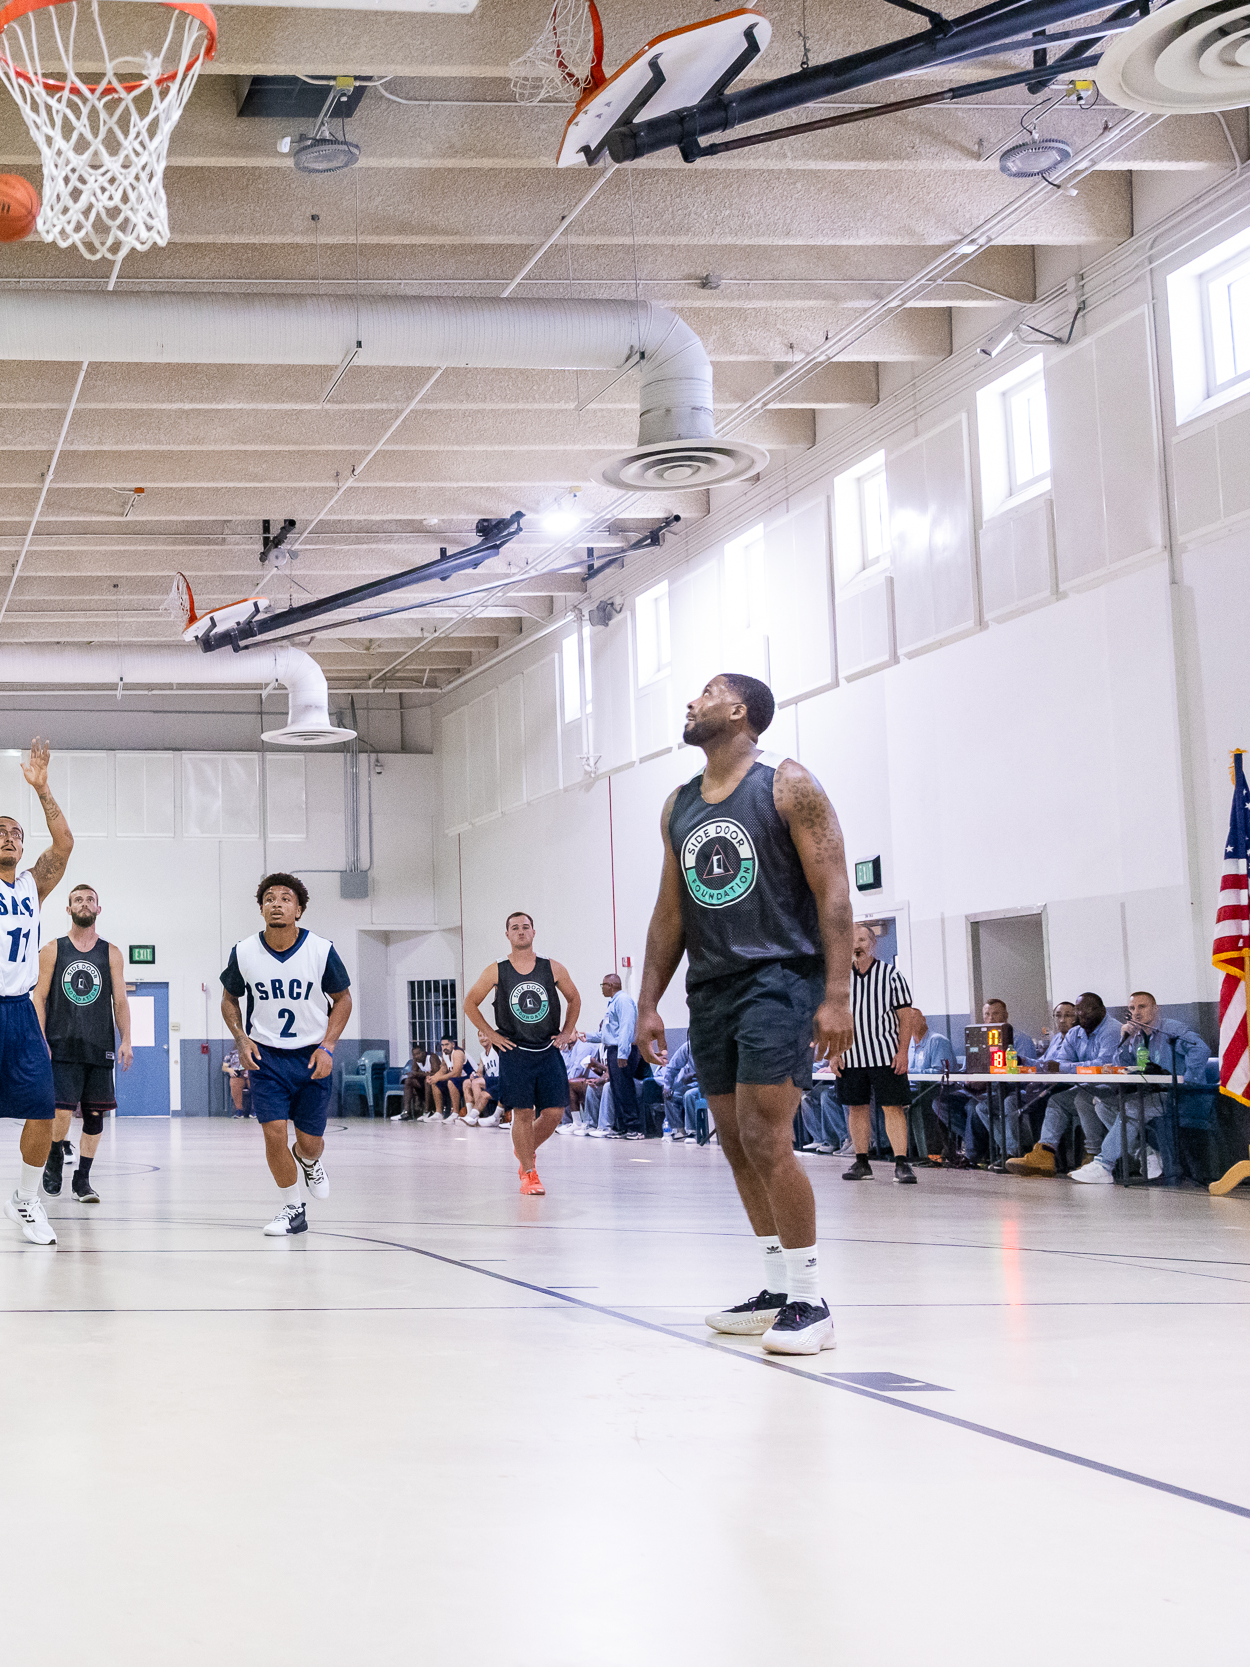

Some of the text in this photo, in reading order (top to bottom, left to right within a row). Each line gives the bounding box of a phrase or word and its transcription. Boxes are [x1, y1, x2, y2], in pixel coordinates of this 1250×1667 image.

[687, 825, 745, 856] SIDE DOOR
[691, 866, 751, 901] FOUNDATION
[134, 948, 152, 960] EXIT
[66, 964, 98, 980] SIDE DOOR
[67, 986, 98, 1002] FOUNDATION
[254, 978, 314, 1001] SRCI
[513, 984, 545, 999] SIDE DOOR
[515, 1003, 548, 1020] FOUNDATION
[277, 1007, 298, 1039] 2
[988, 1029, 999, 1045] 17
[993, 1051, 1004, 1067] 18
